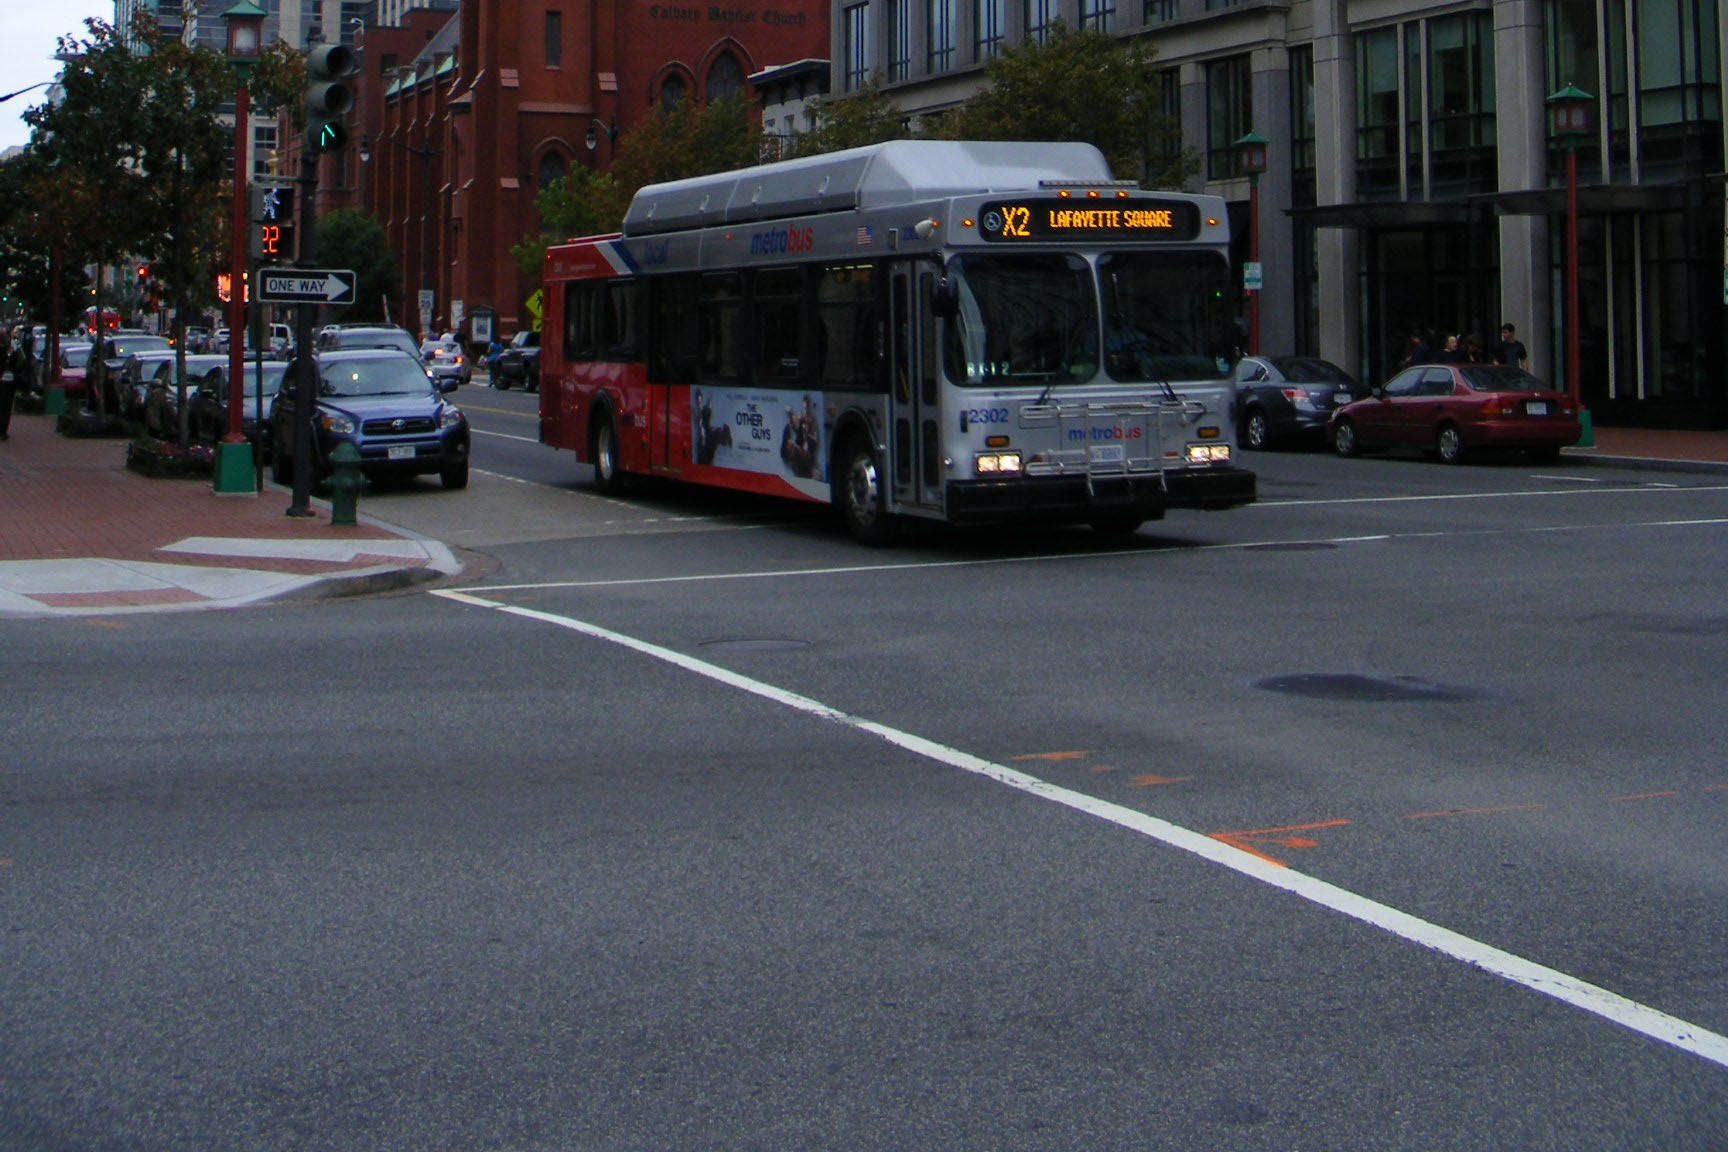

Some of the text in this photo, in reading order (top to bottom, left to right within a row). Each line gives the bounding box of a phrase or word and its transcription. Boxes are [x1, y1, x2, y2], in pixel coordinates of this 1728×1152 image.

[650, 5, 807, 27] Calvary Baptist Church
[1001, 206, 1173, 237] X2 LAFAYETTE SQUARE
[750, 223, 814, 256] metrobus
[269, 279, 326, 293] ONE WAY
[736, 412, 763, 427] OTHER
[968, 408, 1009, 424] 2302
[752, 427, 771, 441] GUYS
